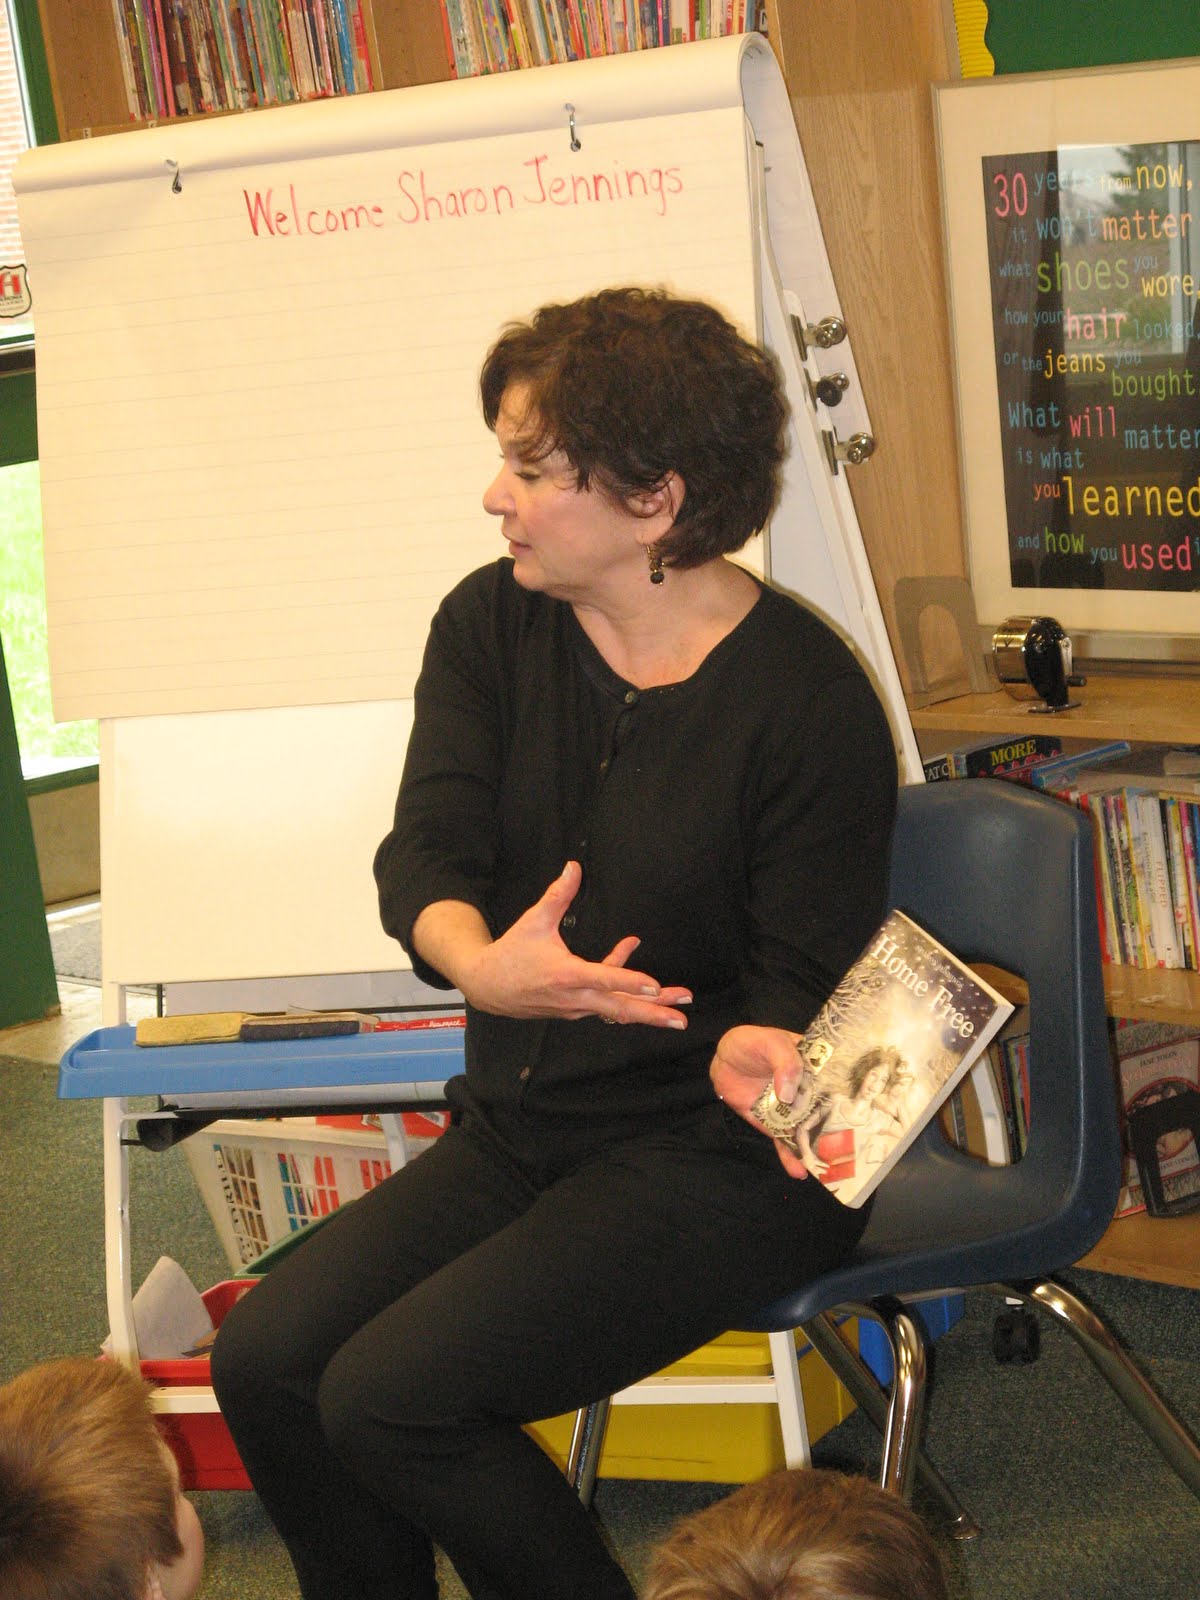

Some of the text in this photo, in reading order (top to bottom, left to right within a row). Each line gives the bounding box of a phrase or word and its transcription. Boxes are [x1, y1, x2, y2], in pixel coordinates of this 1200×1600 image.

[243, 154, 684, 237] Welcome Sharon Jennings
[993, 172, 1028, 217] 30
[1100, 175, 1132, 193] from
[1136, 163, 1193, 192] now,
[1012, 208, 1193, 243] it won't matter
[999, 261, 1031, 278] what
[1036, 251, 1130, 293] shoes
[1133, 255, 1158, 272] you
[1005, 308, 1029, 325] how
[1033, 311, 1064, 327] your
[1065, 307, 1127, 340] hair
[1021, 356, 1043, 371] the
[1044, 348, 1106, 379] jeans
[1114, 351, 1142, 368] you
[1111, 368, 1196, 400] bought
[1007, 401, 1200, 449] What will matter
[1017, 447, 1085, 469] is what
[1034, 475, 1200, 517] you learned
[1017, 534, 1040, 549] and
[1044, 527, 1085, 554] how
[1091, 546, 1118, 564] you
[1122, 535, 1192, 571] used
[990, 739, 1037, 767] MORE
[1156, 860, 1168, 908] FLIPPED
[871, 935, 975, 1038] Home Free
